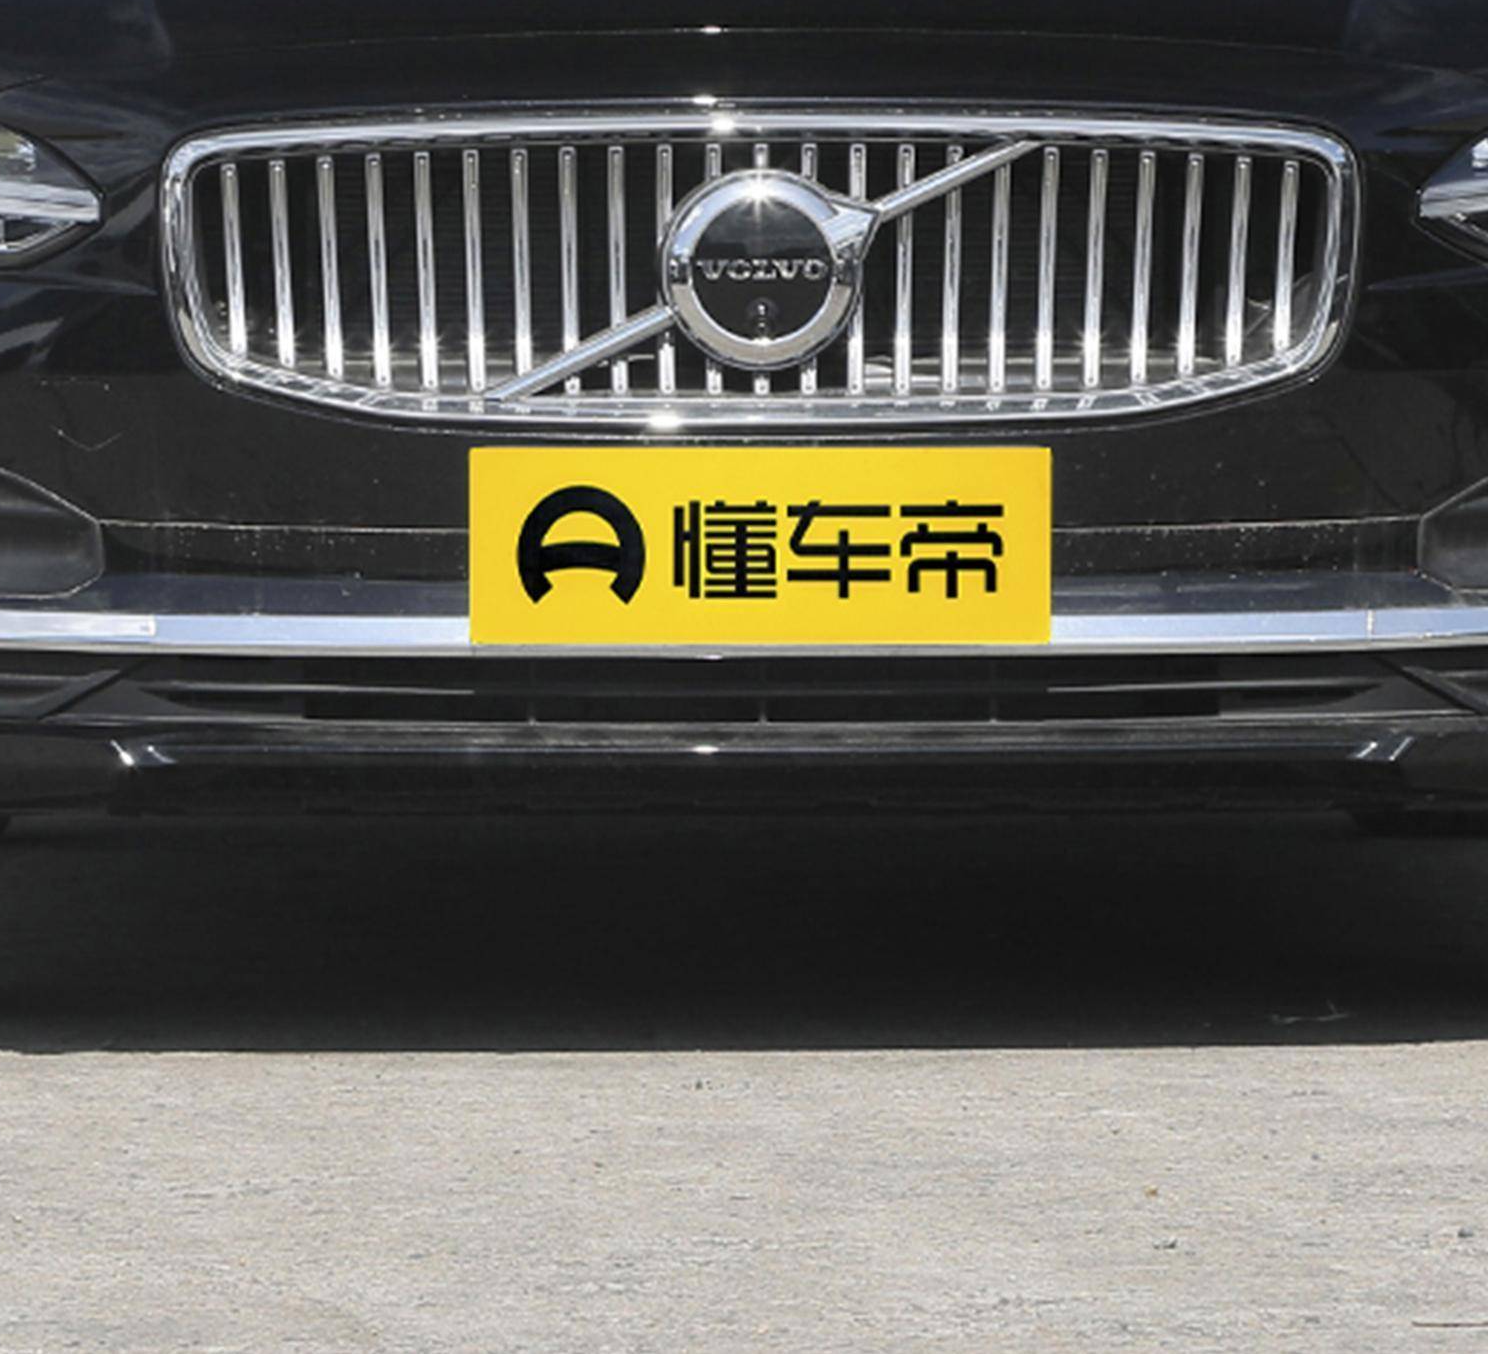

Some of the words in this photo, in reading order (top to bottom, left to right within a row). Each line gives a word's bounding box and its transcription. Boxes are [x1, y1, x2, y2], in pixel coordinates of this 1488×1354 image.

[695, 258, 829, 281] VOLVO
[672, 499, 1004, 599] 懂车帝
